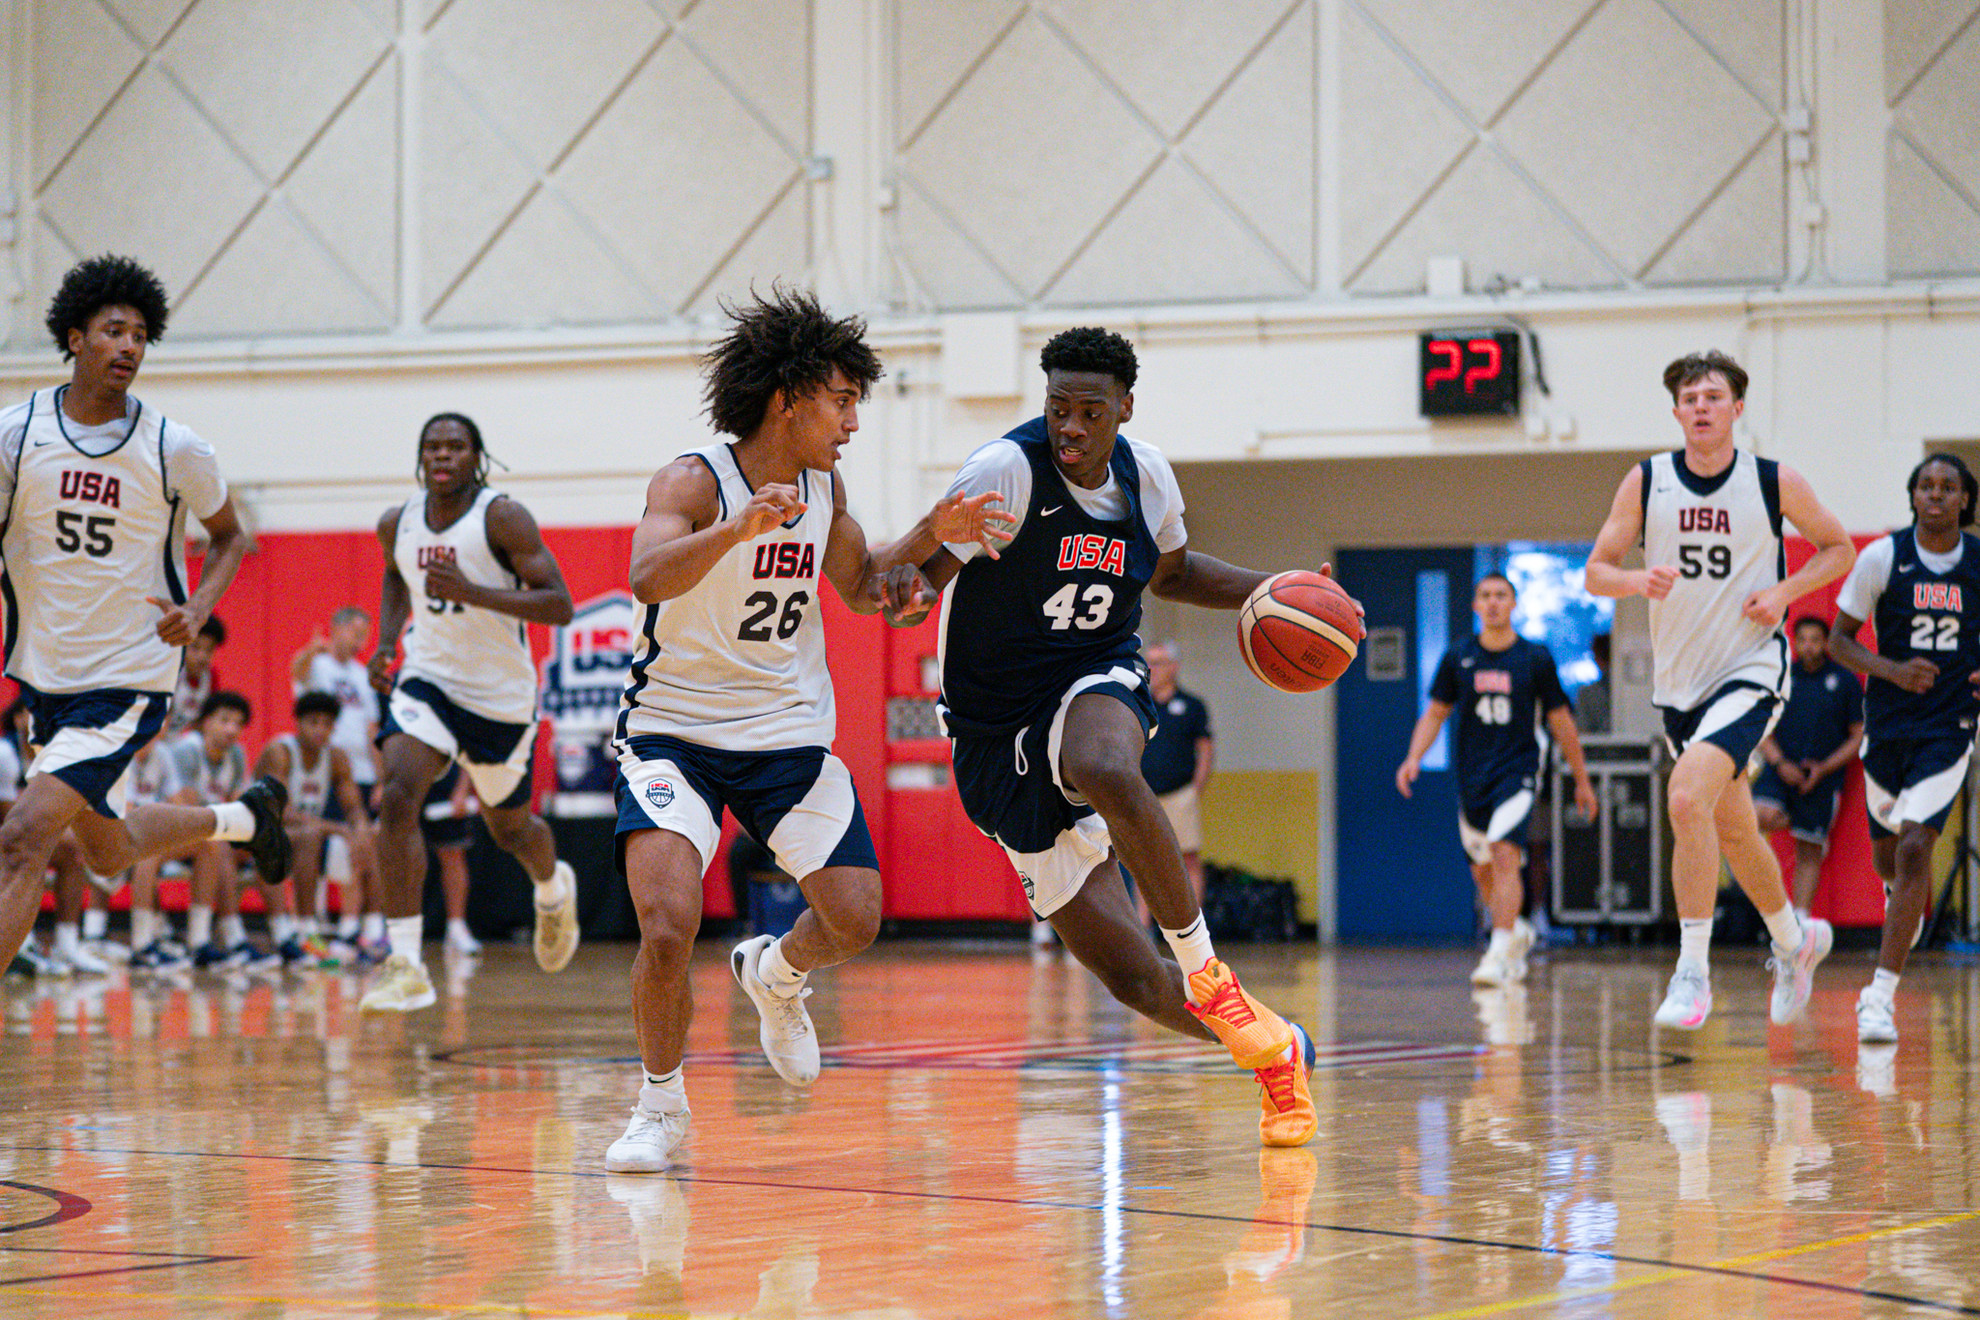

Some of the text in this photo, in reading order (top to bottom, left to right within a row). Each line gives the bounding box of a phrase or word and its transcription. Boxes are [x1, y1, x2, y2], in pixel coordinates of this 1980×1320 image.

[60, 470, 120, 510] USA
[55, 510, 116, 557] 55
[1679, 507, 1731, 535] USA
[752, 542, 815, 580] USA
[1057, 533, 1126, 577] USA
[1679, 544, 1732, 580] 59
[737, 590, 810, 642] 26
[1042, 583, 1115, 630] 43
[1913, 582, 1963, 613] USA
[573, 627, 635, 673] US
[1910, 614, 1960, 651] 22
[1300, 650, 1326, 670] FIBA
